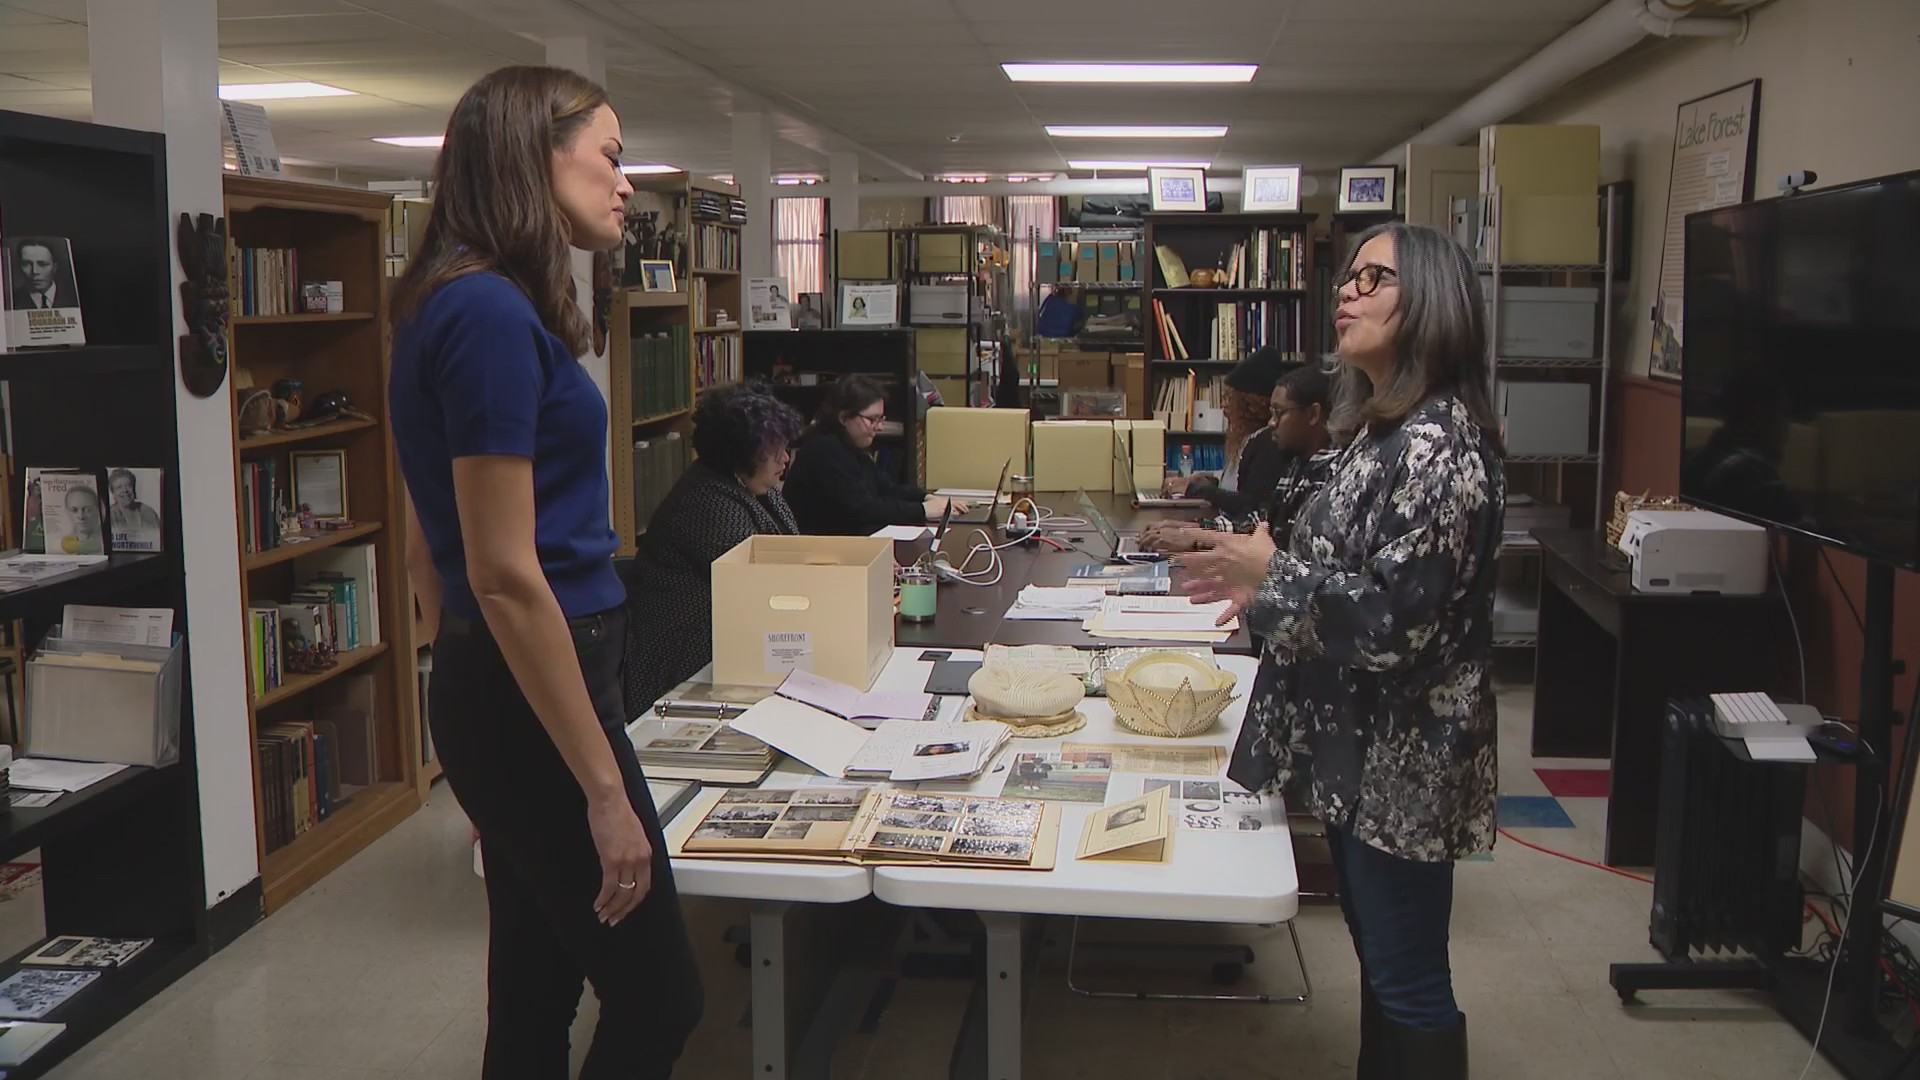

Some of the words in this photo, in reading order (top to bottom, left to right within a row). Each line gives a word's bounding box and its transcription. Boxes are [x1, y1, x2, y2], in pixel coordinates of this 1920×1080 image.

[1678, 106, 1705, 150] Lake
[1706, 105, 1745, 143] Forest
[222, 101, 250, 175] SHOREFRONT
[47, 483, 67, 492] Fred
[115, 533, 128, 541] LIFE
[768, 633, 806, 643] SHOREFRONT
